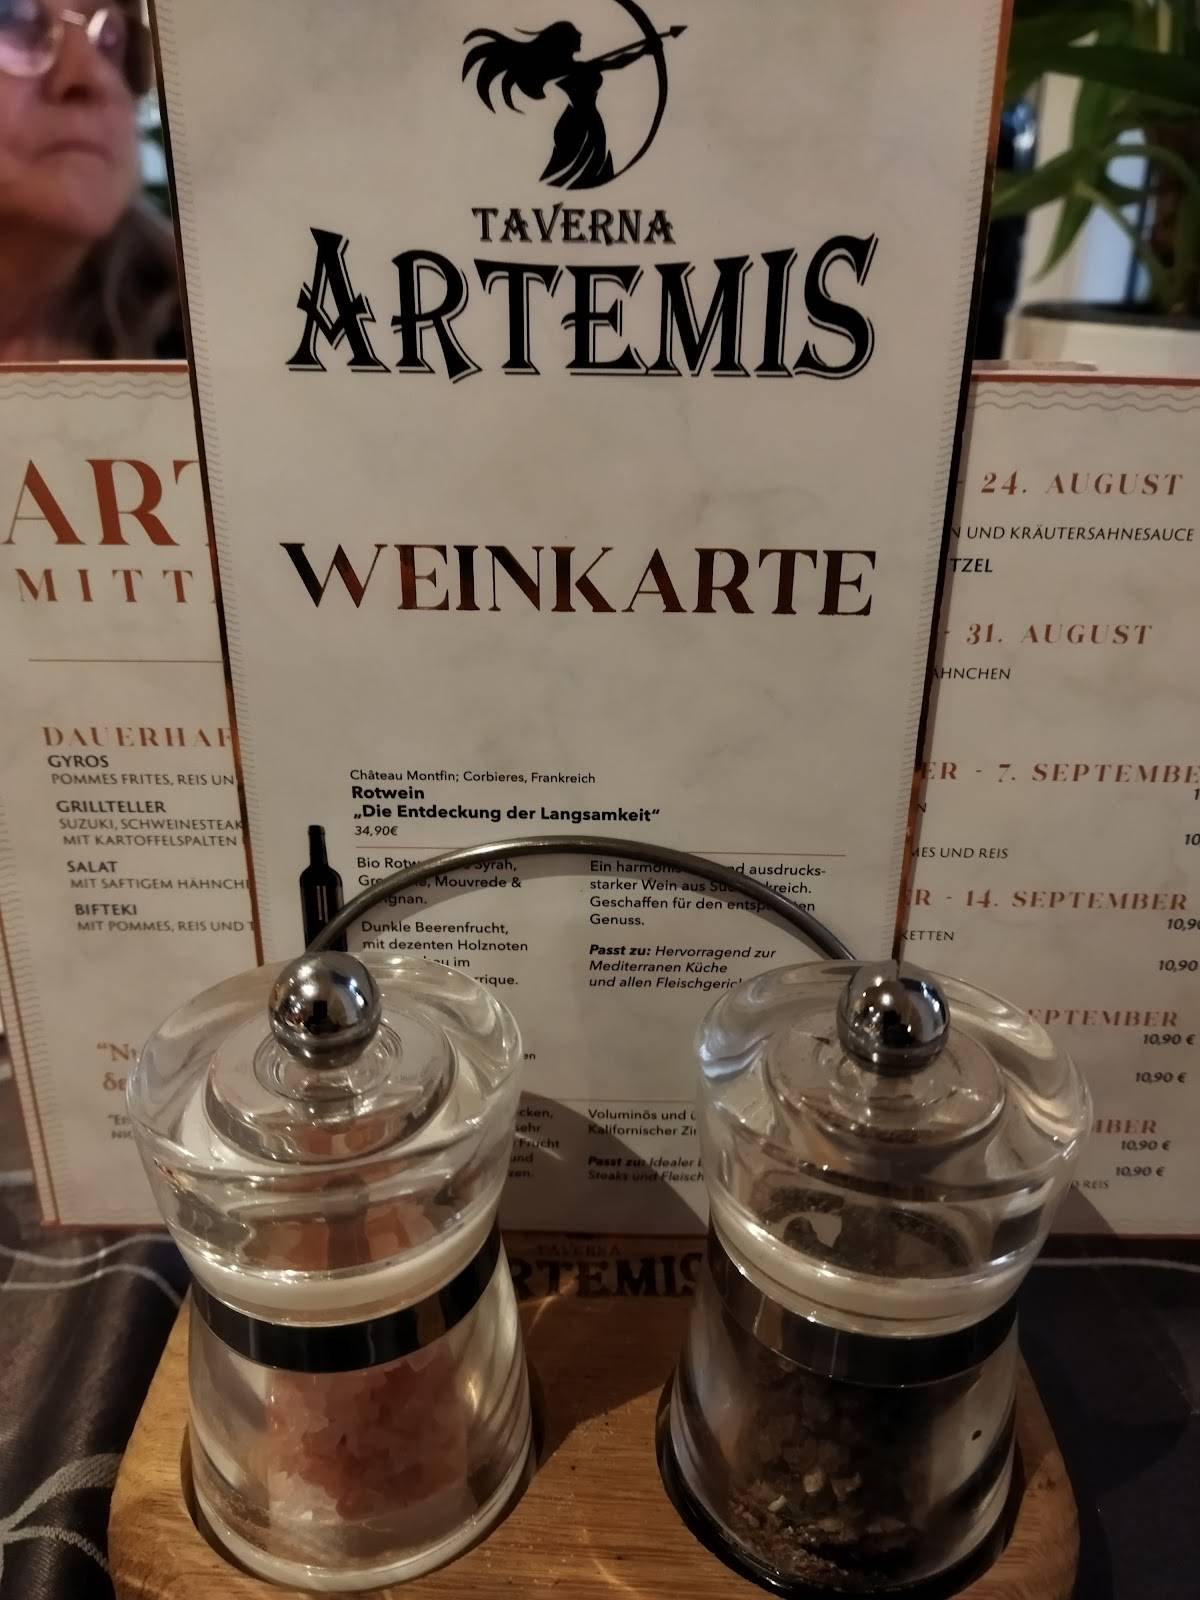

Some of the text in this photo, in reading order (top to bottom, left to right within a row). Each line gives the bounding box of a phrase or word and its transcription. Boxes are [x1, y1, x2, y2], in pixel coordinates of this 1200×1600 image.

[471, 202, 676, 246] TAVERNA
[285, 227, 879, 384] ARTEMIS
[981, 470, 1027, 496] 24.
[1045, 471, 1183, 496] AUGUST
[967, 526, 1006, 540] UND
[1010, 524, 1195, 542] KRÄUTERSAHNESAUCE
[14, 567, 216, 604] MITT
[280, 542, 877, 616] WEINKARTE
[966, 623, 1003, 645] 31.
[1020, 624, 1152, 645] AUGUST
[47, 755, 110, 769] GYROS
[51, 773, 118, 785] POMMES
[121, 773, 174, 786] FRITES,
[177, 774, 208, 786] REIS
[350, 769, 596, 784] Château Montfin; Corbieres, Frankreich
[997, 763, 1016, 783] 7.
[351, 786, 425, 800] Rotwein
[56, 800, 167, 813] GRILLTELLER
[353, 804, 661, 823] „Die Entdeckung der Langsamkeit“
[59, 818, 118, 831] SUZUKI,
[354, 825, 399, 837] 34,90€
[63, 834, 238, 847] MIT KARTOFFELSPALTEN
[940, 848, 975, 859] UND
[978, 848, 1009, 860] REIS
[66, 860, 118, 873] SALAT
[357, 857, 380, 869] Bio
[590, 860, 613, 873] Ein
[749, 864, 827, 877] ausdrucks-
[70, 878, 97, 889] MIT
[101, 878, 173, 890] SAFTIGEM
[435, 876, 507, 888] Mouvrede
[511, 876, 521, 888] &
[590, 879, 637, 891] starker
[641, 880, 678, 892] Wein
[681, 882, 706, 892] aus
[590, 896, 668, 909] Geschaffen
[672, 896, 692, 909] für
[696, 898, 723, 910] den
[966, 888, 998, 908] 14.
[1011, 890, 1188, 911] SEPTEMBER
[75, 904, 138, 916] BIFTEKI
[590, 914, 645, 926] Genuss.
[78, 921, 103, 932] MIT
[108, 921, 175, 933] POMMES,
[178, 921, 207, 932] REIS
[210, 921, 244, 932] UND
[361, 921, 509, 935] Dunkle Beerenfrucht,
[363, 939, 529, 952] mit dezenten Holznoten
[589, 945, 776, 960] Passt zu: Hervorragend zur
[453, 956, 470, 967] im
[589, 961, 728, 974] Mediterranen Küche
[1159, 959, 1199, 973] 10,90
[589, 976, 616, 988] und
[619, 977, 652, 988] allen
[1143, 1033, 1197, 1046] 10,90 €
[1135, 1071, 1188, 1084] 10,90 €
[588, 1108, 657, 1121] Voluminös
[660, 1109, 683, 1121] und
[587, 1125, 678, 1137] Kalifornischer
[1121, 1139, 1172, 1151] 10,90 €
[588, 1156, 622, 1167] Passt
[649, 1157, 694, 1168] Idealer
[587, 1171, 628, 1182] Steaks
[631, 1171, 659, 1182] und
[1115, 1166, 1166, 1177] 10,90 €
[508, 1252, 703, 1299] RTEMIS
